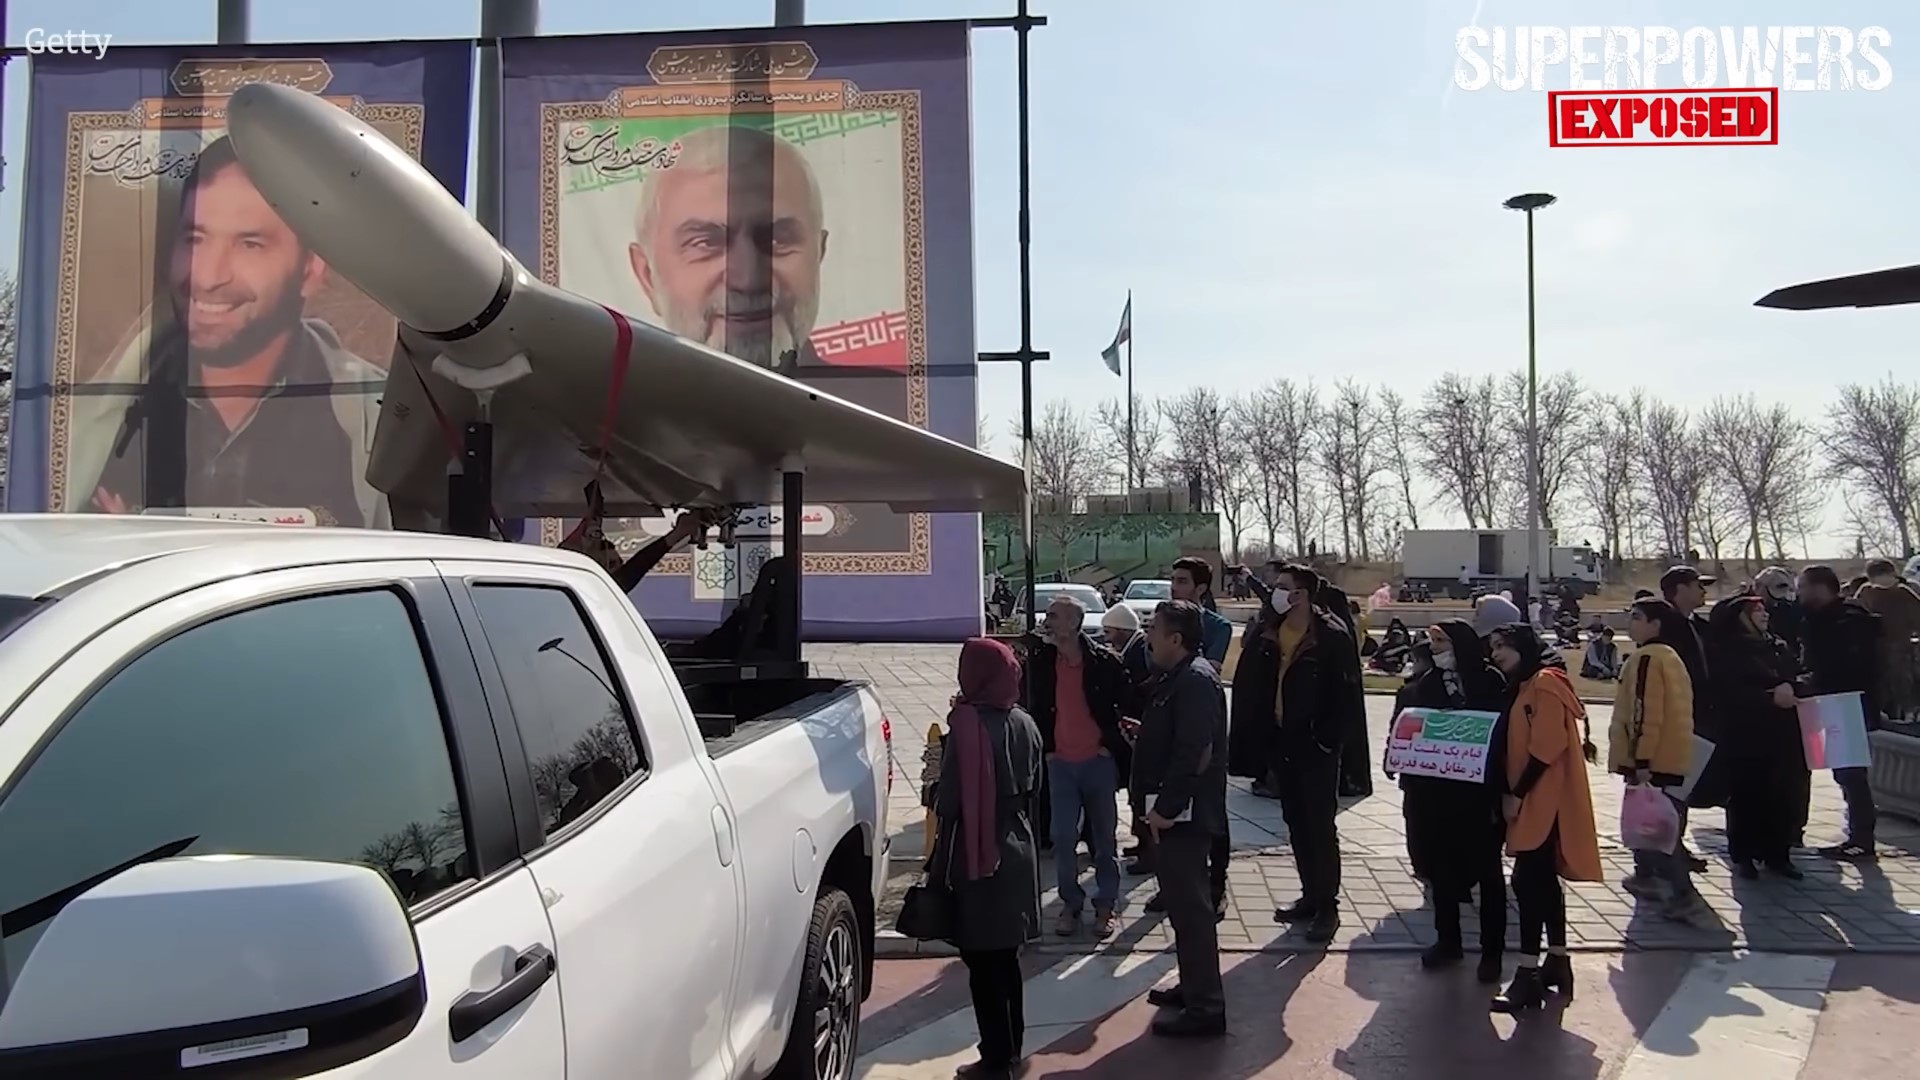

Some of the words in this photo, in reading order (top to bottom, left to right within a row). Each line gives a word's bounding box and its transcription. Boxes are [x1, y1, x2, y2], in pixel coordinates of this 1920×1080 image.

[626, 95, 661, 108] اسلامی
[661, 95, 694, 107] انقلاب
[757, 512, 783, 529] حاج
[1469, 766, 1483, 778] در
